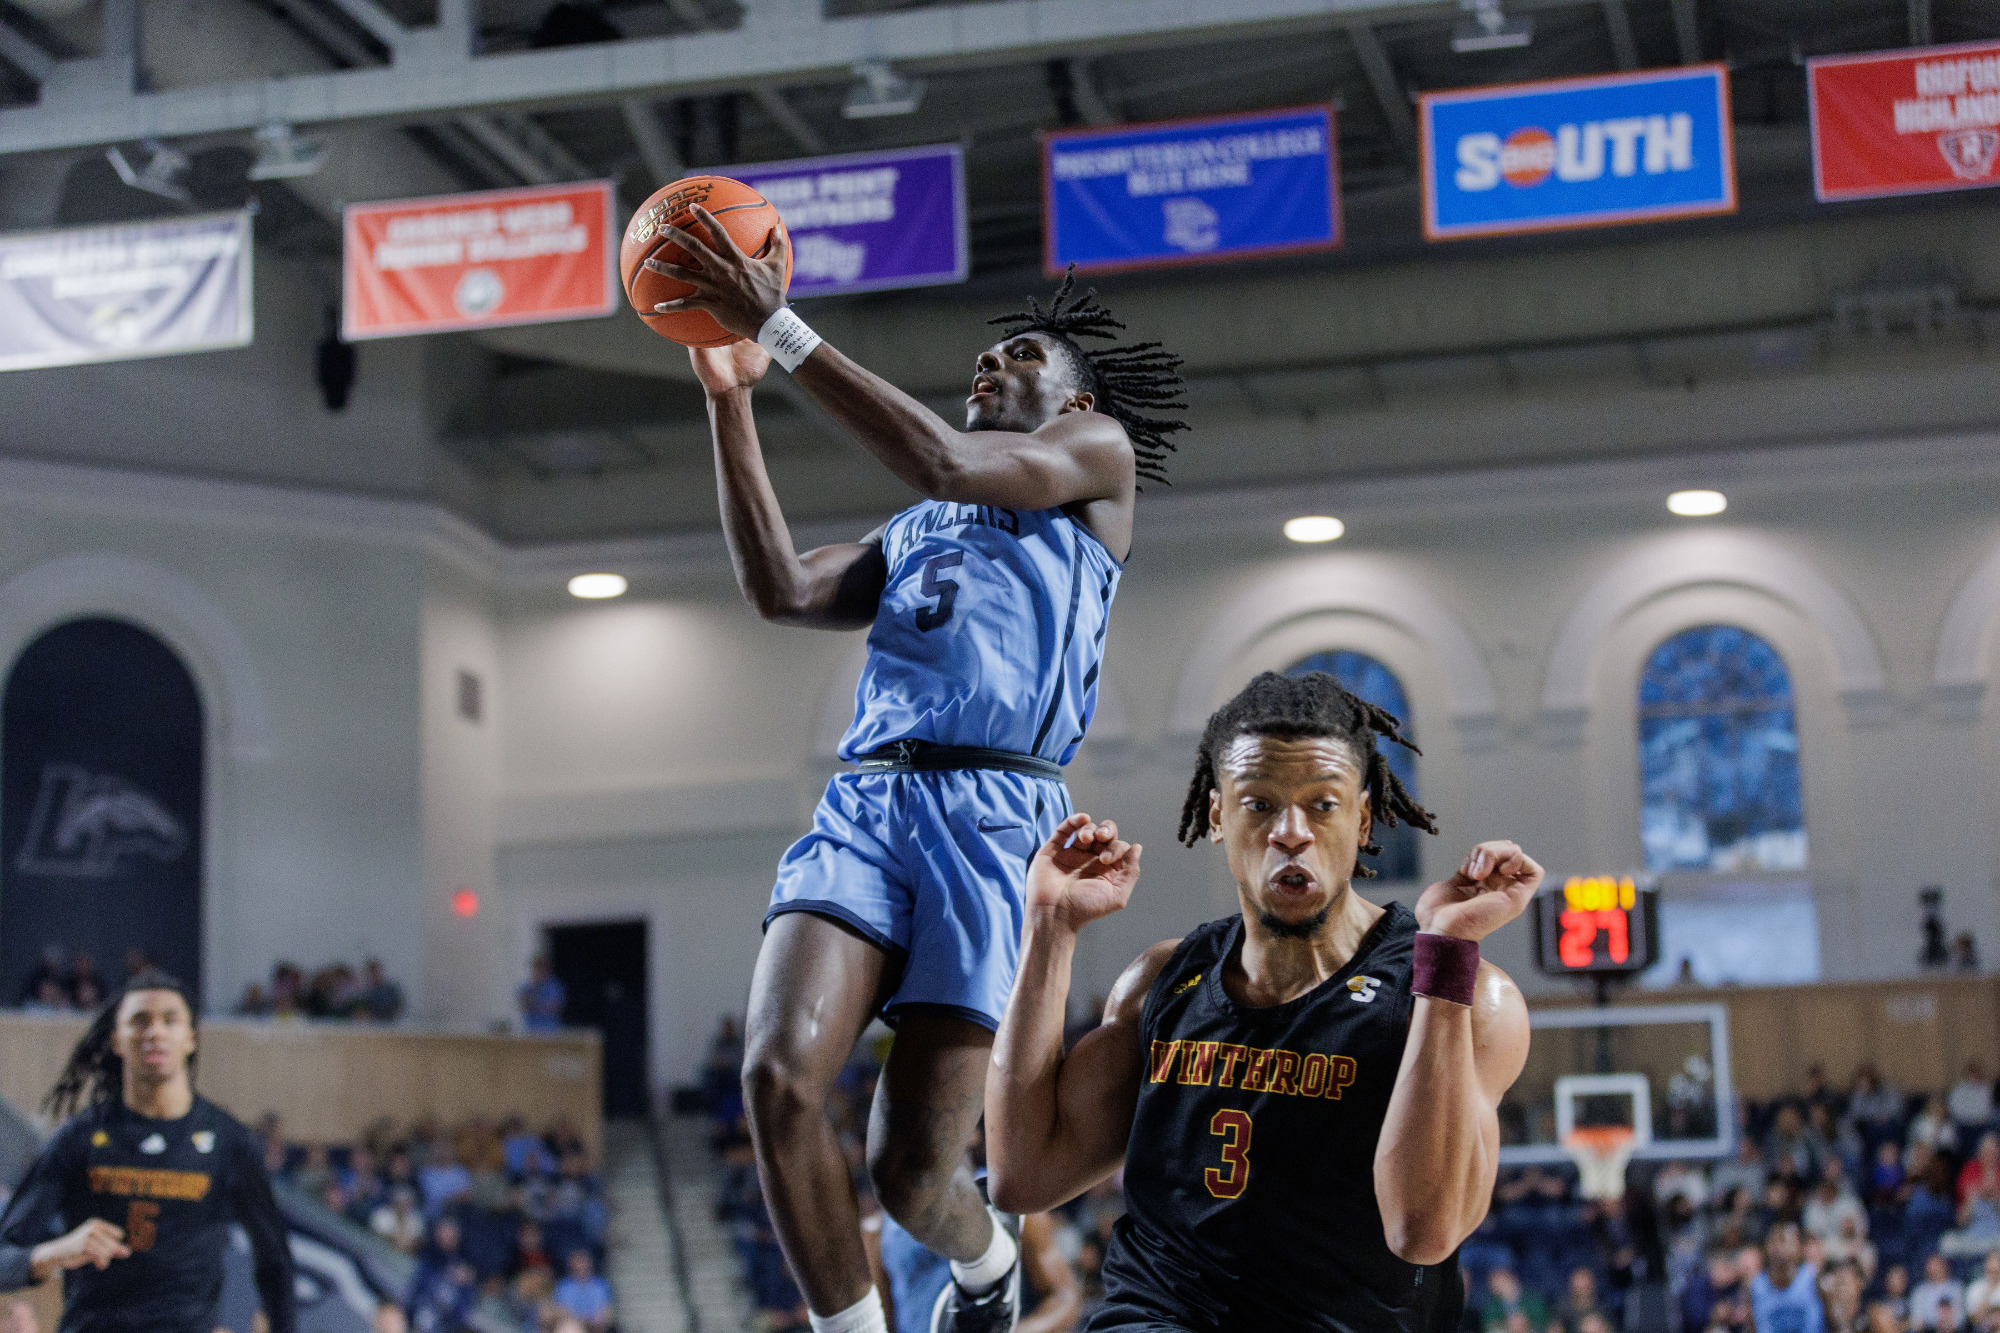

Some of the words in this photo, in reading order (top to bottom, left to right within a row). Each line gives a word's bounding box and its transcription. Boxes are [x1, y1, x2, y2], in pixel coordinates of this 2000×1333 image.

[1914, 54, 2000, 95] RADFOR
[1893, 91, 2000, 134] HIGHLAND
[915, 550, 964, 633] 5
[1559, 907, 1629, 968] 27
[1150, 1039, 1357, 1100] WINTHROP
[1204, 1108, 1252, 1199] 3
